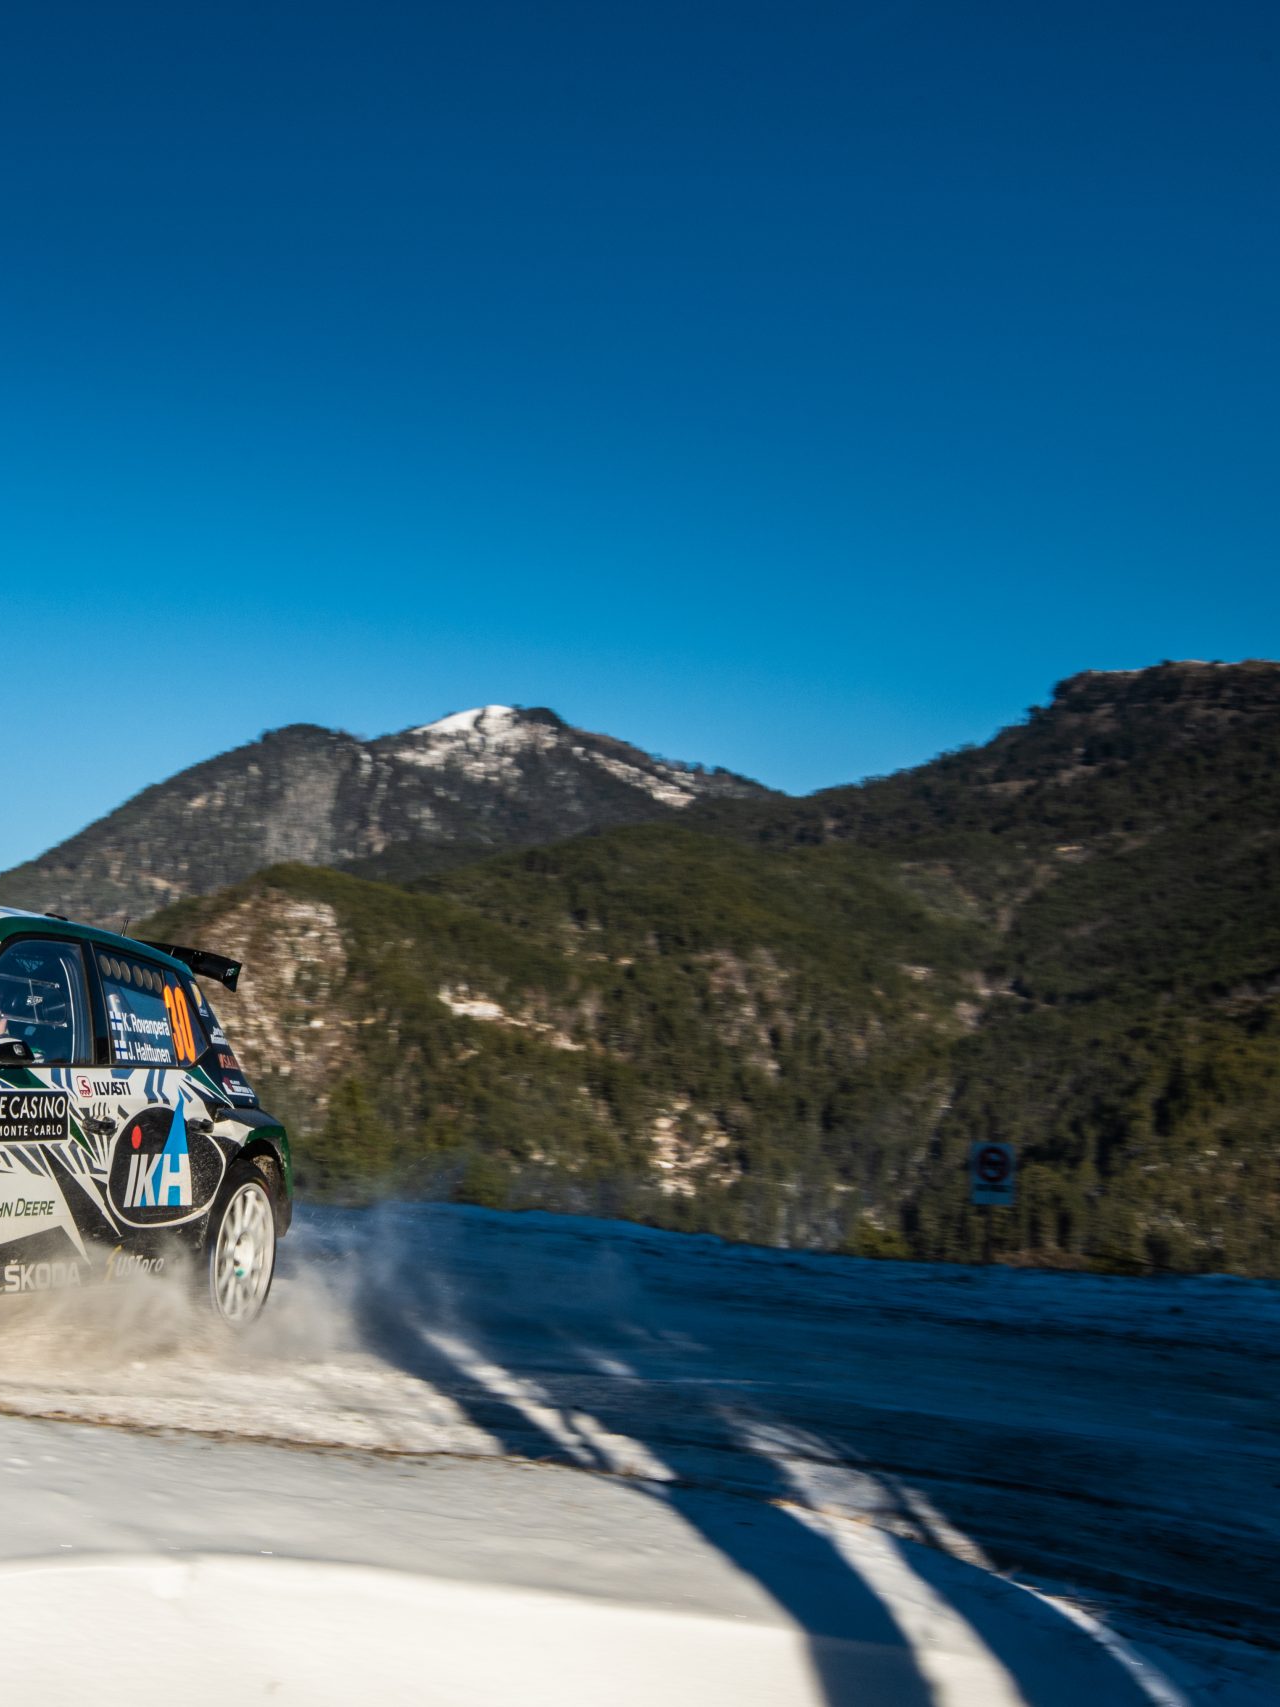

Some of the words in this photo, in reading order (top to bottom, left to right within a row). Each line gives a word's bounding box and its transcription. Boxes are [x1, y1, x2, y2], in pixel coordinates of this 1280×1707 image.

[163, 984, 196, 1063] 30
[9, 1095, 67, 1119] CASINO
[14, 1198, 56, 1217] DEERE
[4, 1259, 81, 1292] ŠKODA
